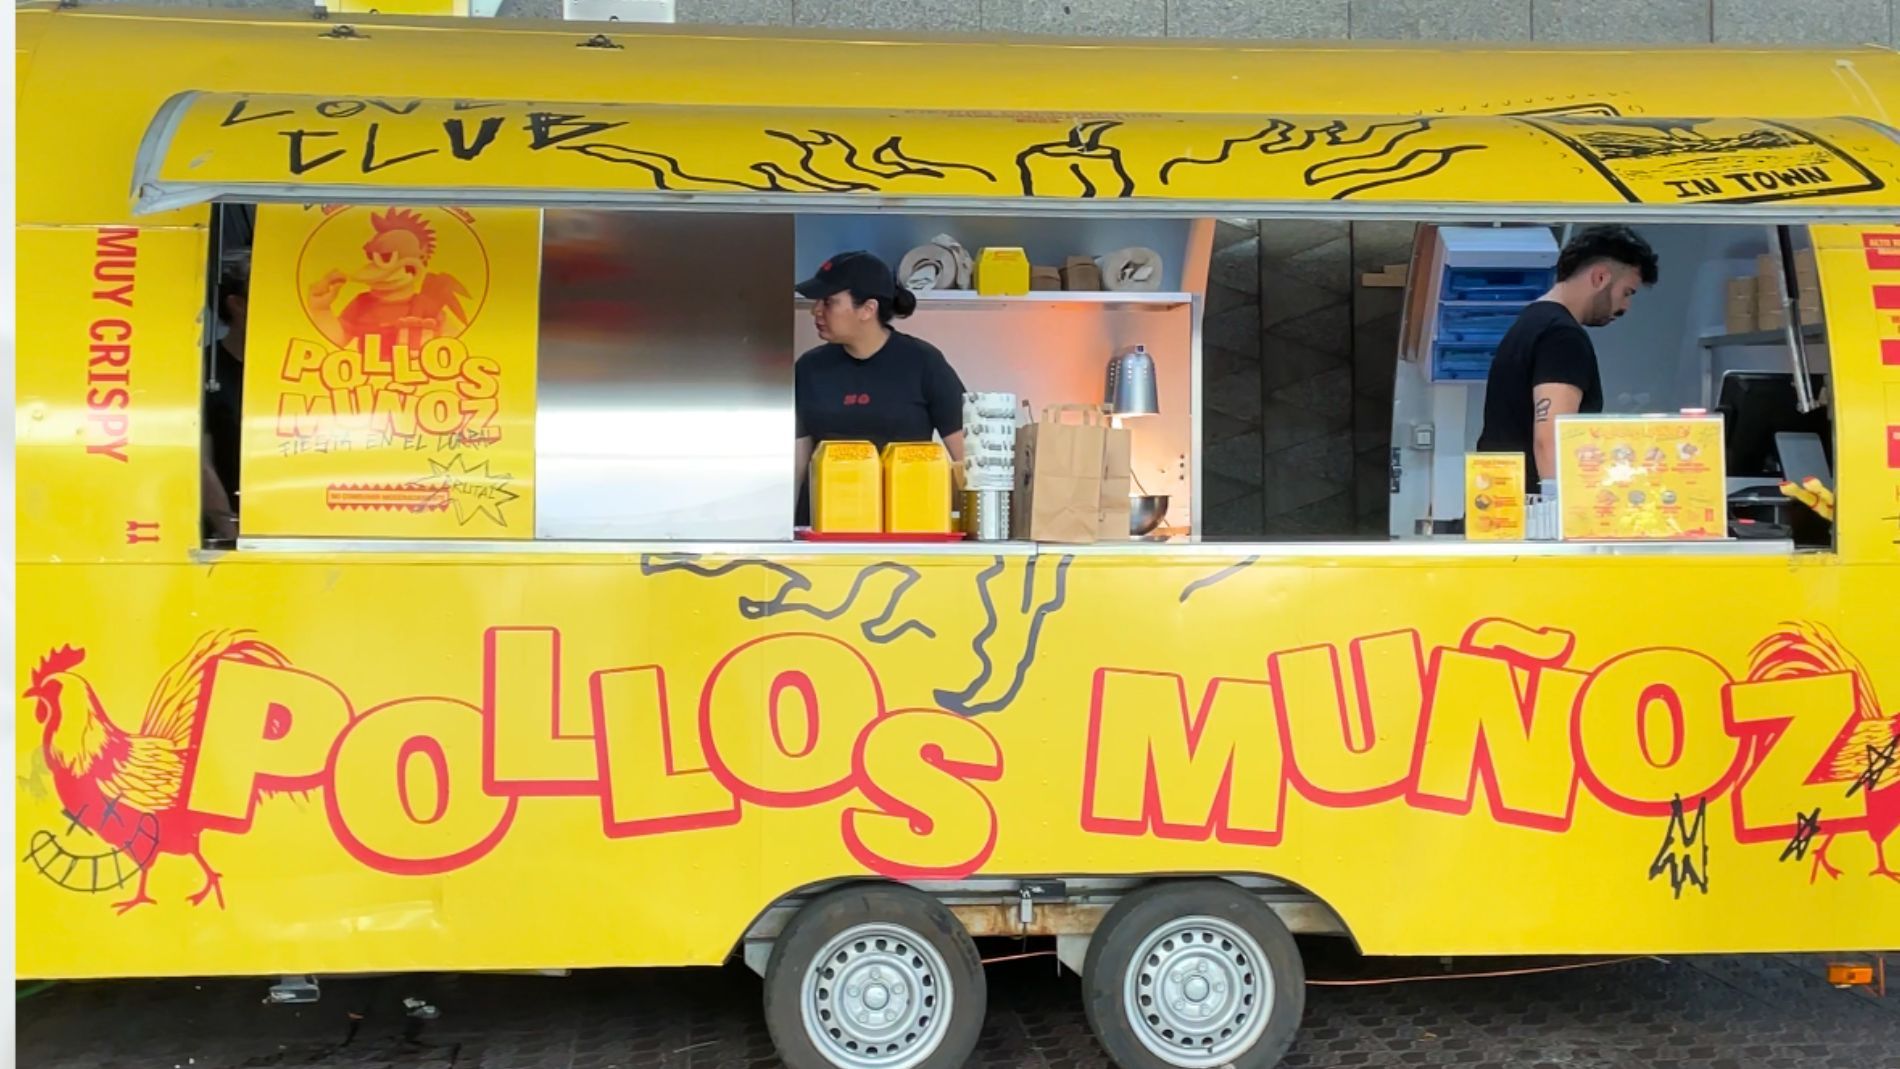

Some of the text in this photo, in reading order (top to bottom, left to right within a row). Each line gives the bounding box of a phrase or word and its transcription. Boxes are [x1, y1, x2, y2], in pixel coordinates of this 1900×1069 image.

[1664, 165, 1832, 199] IN TOWN
[86, 227, 139, 463] MUY CRISPY
[281, 333, 501, 400] POLLOS
[276, 382, 501, 445] MUÑOZ
[366, 430, 393, 450] EN
[403, 432, 428, 451] EL
[183, 616, 1866, 879] POLLOS MUÑOZ
